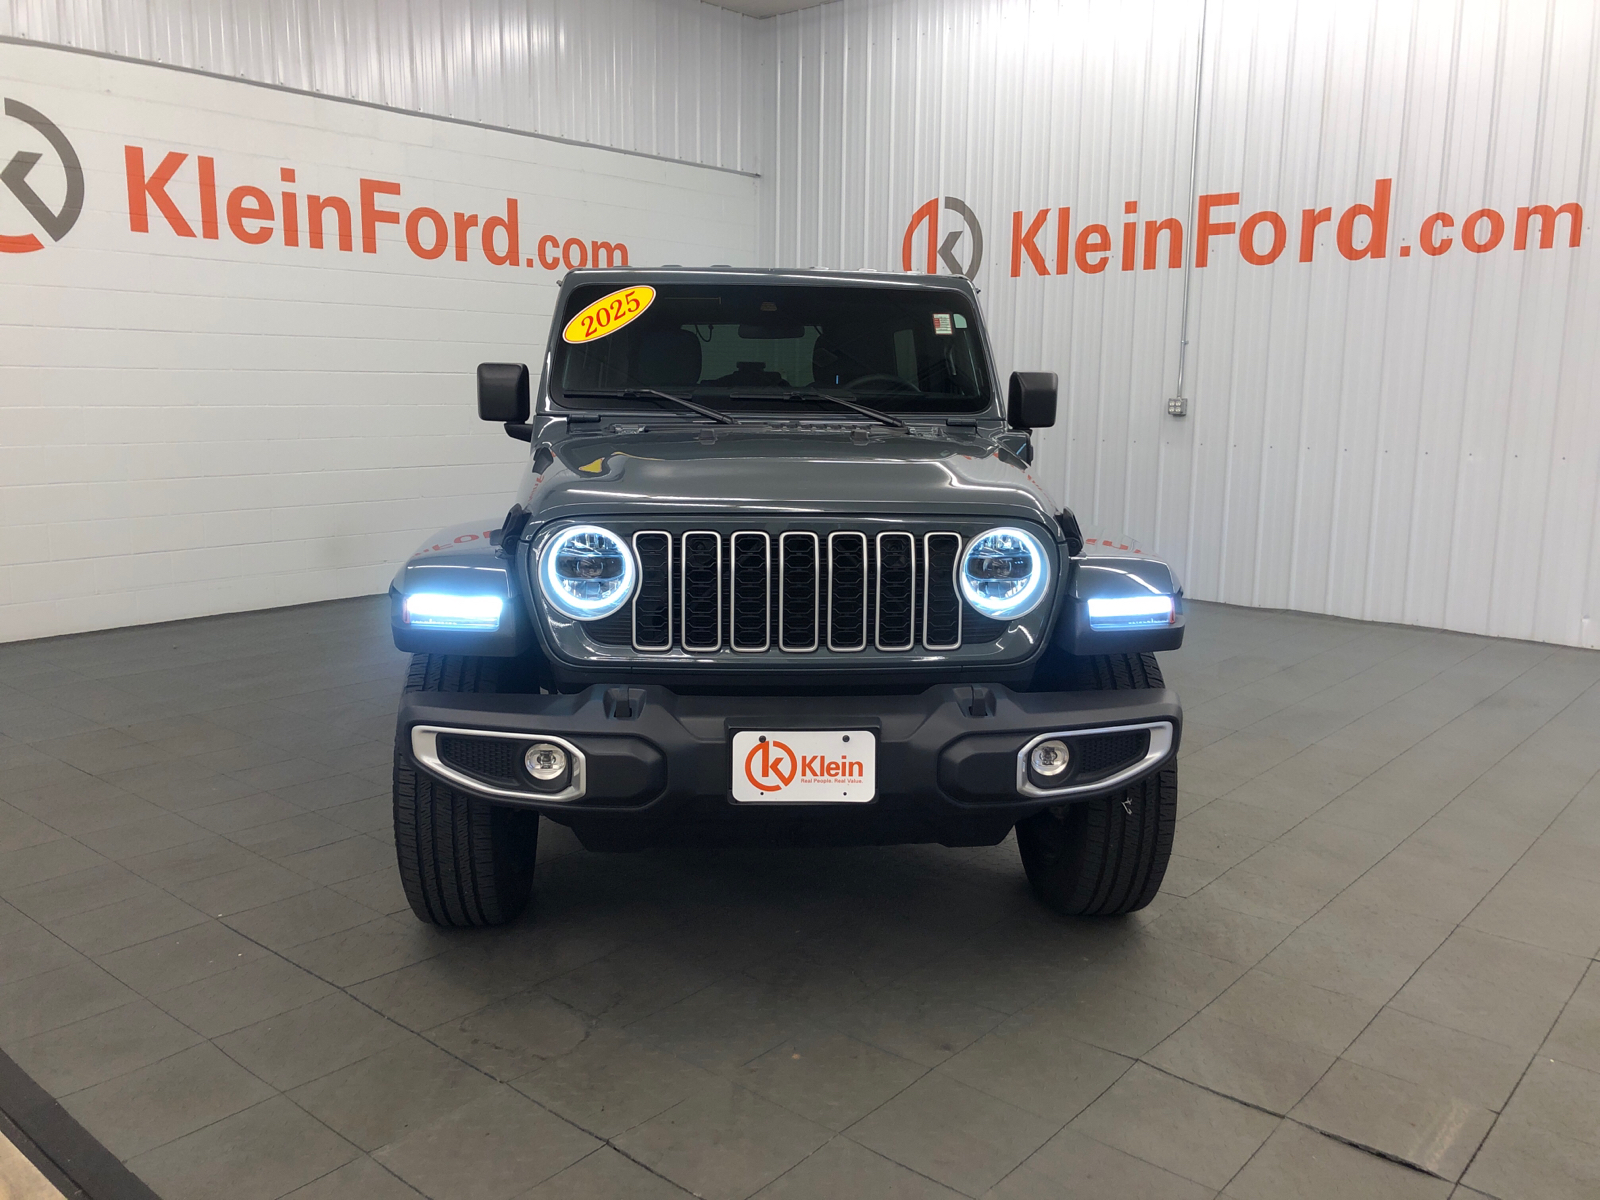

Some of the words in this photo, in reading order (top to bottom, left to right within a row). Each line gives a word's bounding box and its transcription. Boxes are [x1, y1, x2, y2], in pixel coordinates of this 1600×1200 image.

[124, 145, 629, 271] KleinFord.com
[1010, 178, 1584, 278] KleinFord.com
[581, 290, 640, 338] 2025
[801, 755, 863, 777] Klein
